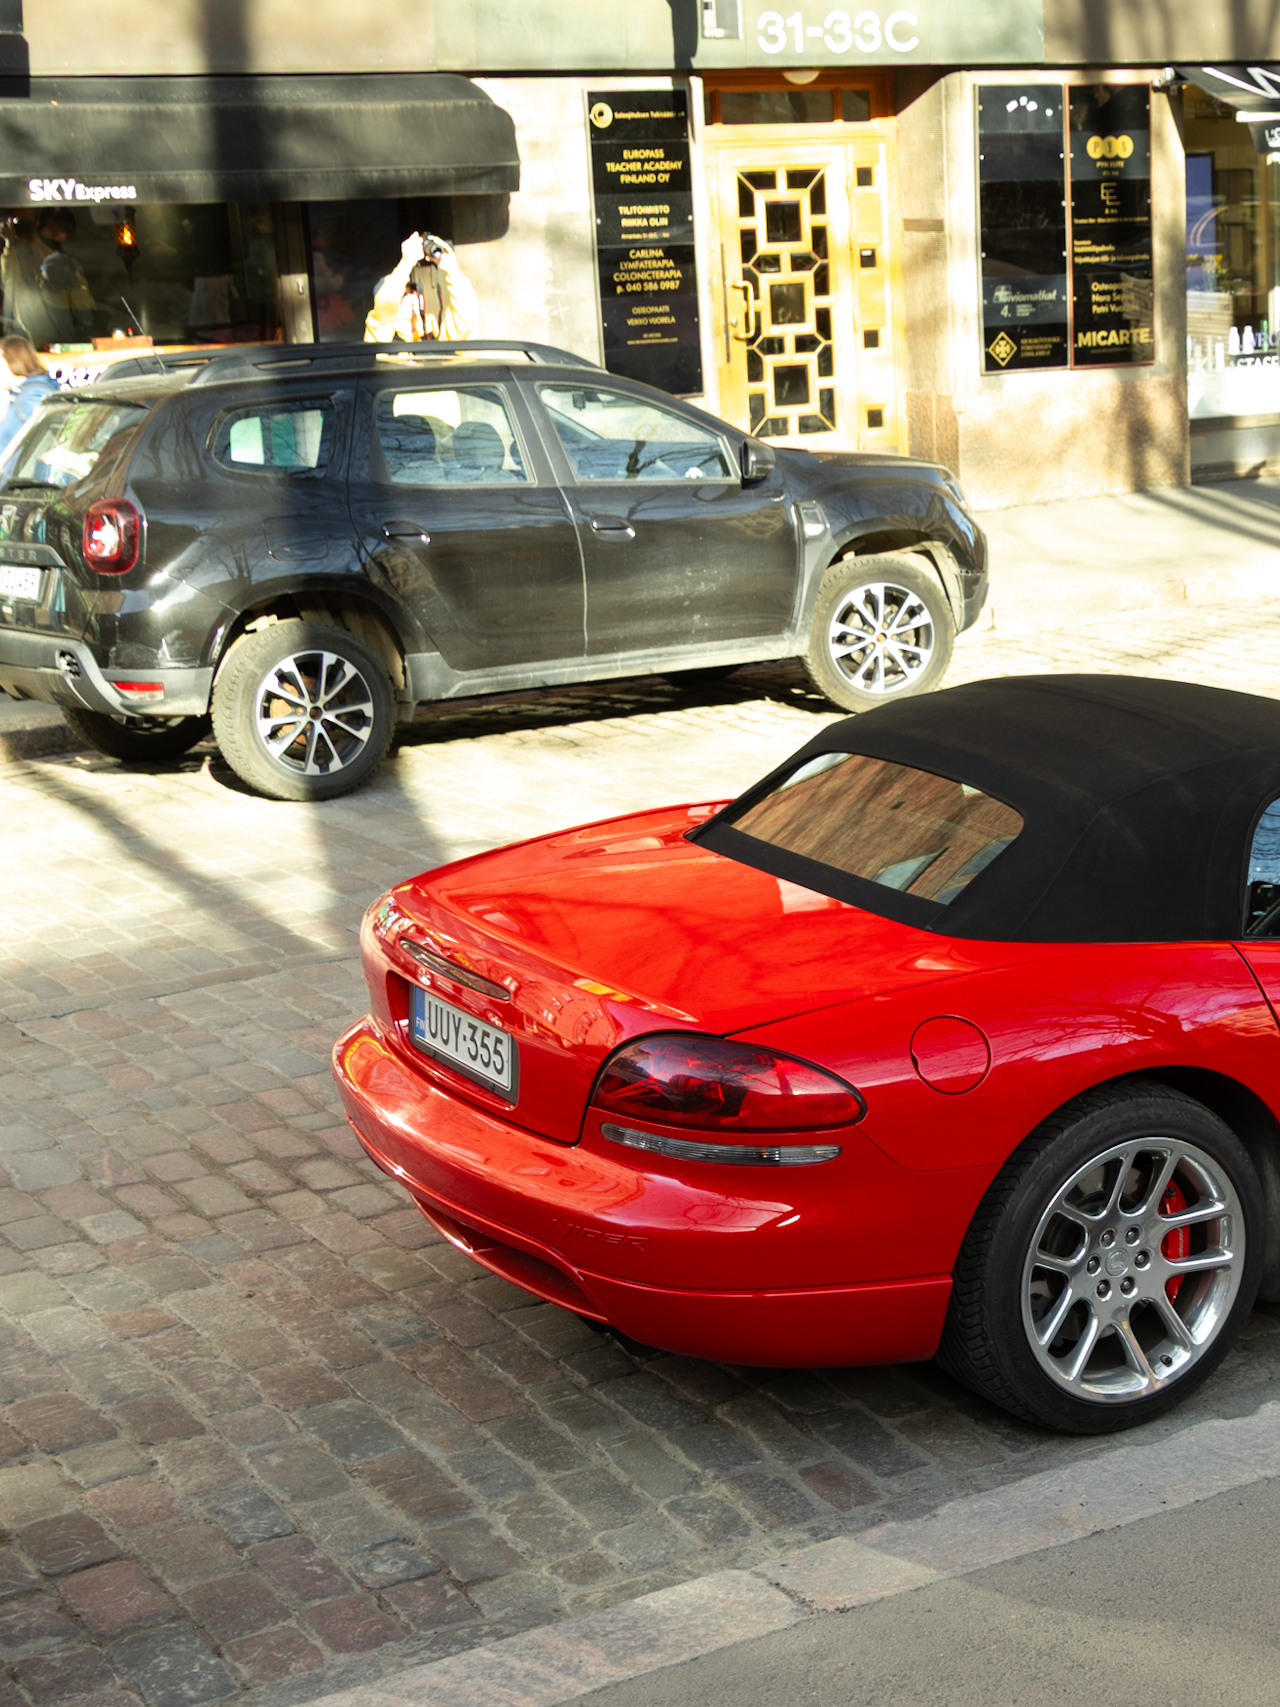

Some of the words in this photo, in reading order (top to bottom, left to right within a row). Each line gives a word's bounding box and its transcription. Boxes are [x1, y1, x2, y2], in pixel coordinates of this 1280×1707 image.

[757, 9, 920, 54] 31-33C
[623, 148, 665, 160] EUROPASS
[606, 161, 642, 172] TEACHER
[643, 160, 683, 171] ACADEMY
[620, 173, 656, 184] FINLAND
[657, 172, 670, 183] OY
[28, 178, 77, 202] SKY
[75, 183, 137, 203] Express
[618, 205, 670, 215] TILITOIMISTO
[621, 218, 648, 228] RIIKKA
[649, 217, 668, 226] OLIN
[629, 248, 664, 260] CARLINA
[619, 259, 675, 271] LYMFATERAPIA
[613, 269, 682, 282] COLONICTERAPIA
[625, 282, 642, 293] 040
[660, 280, 680, 291] 0987
[1078, 327, 1150, 347] MICARTE
[428, 1000, 504, 1075] UUY-355
[552, 1218, 650, 1253] VIPER
